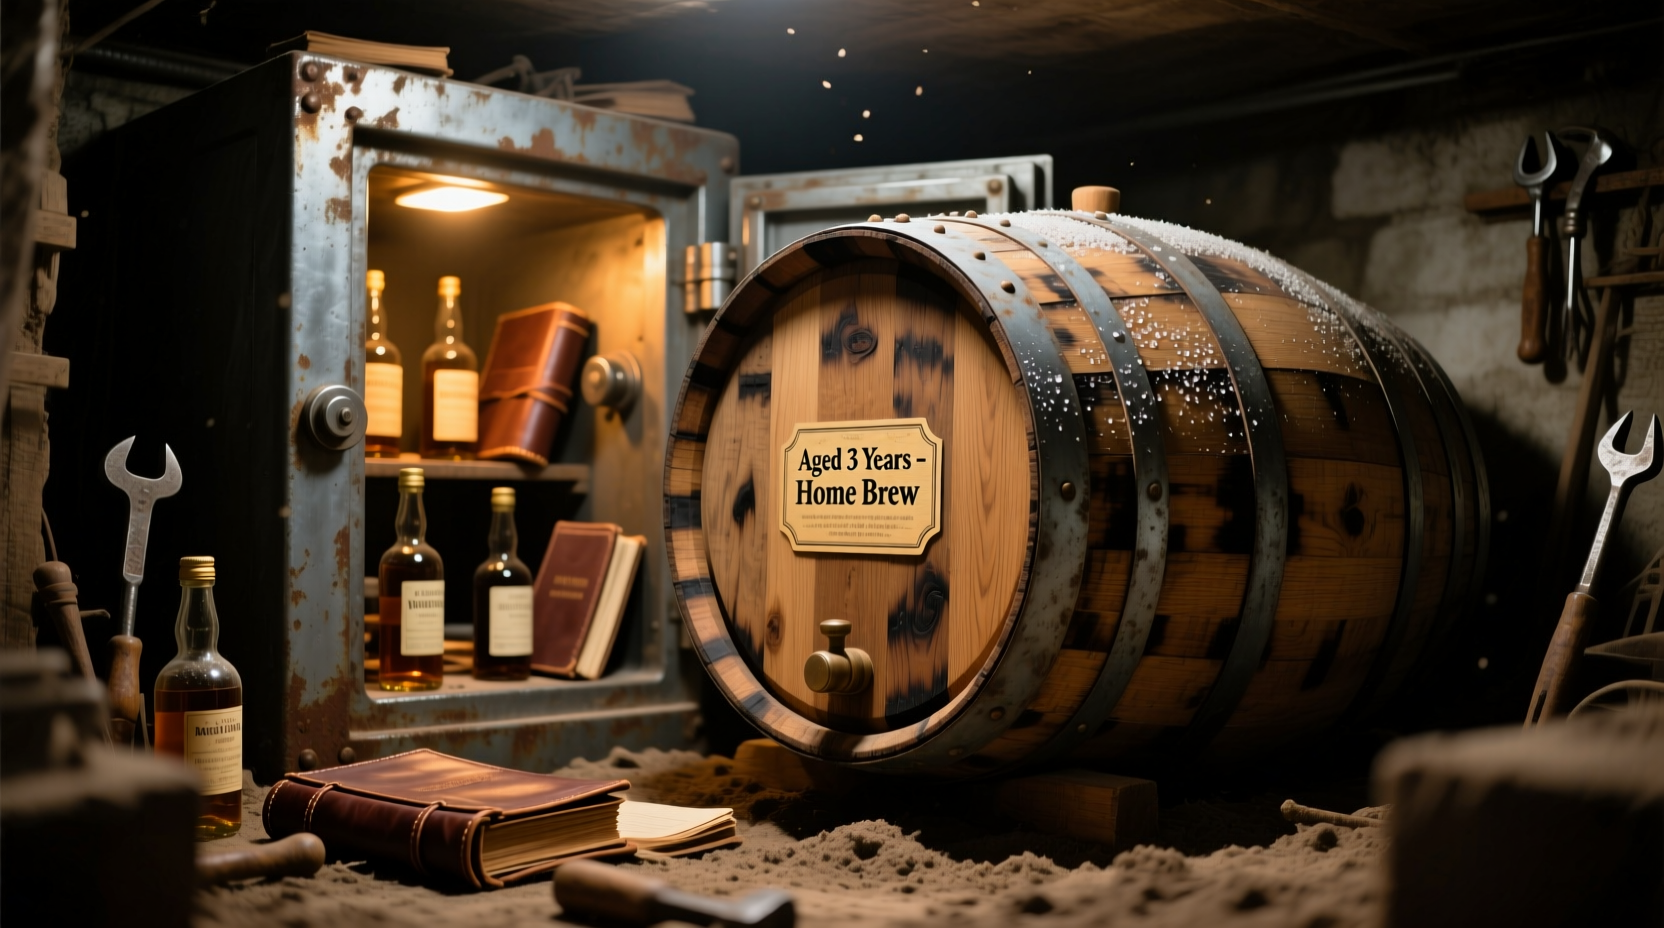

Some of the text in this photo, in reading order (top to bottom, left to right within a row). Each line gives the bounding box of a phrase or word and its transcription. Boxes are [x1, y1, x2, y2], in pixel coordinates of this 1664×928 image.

[798, 447, 842, 478] Aged
[847, 448, 858, 470] 3
[862, 447, 911, 470] Years
[796, 479, 919, 505] Home Brew
